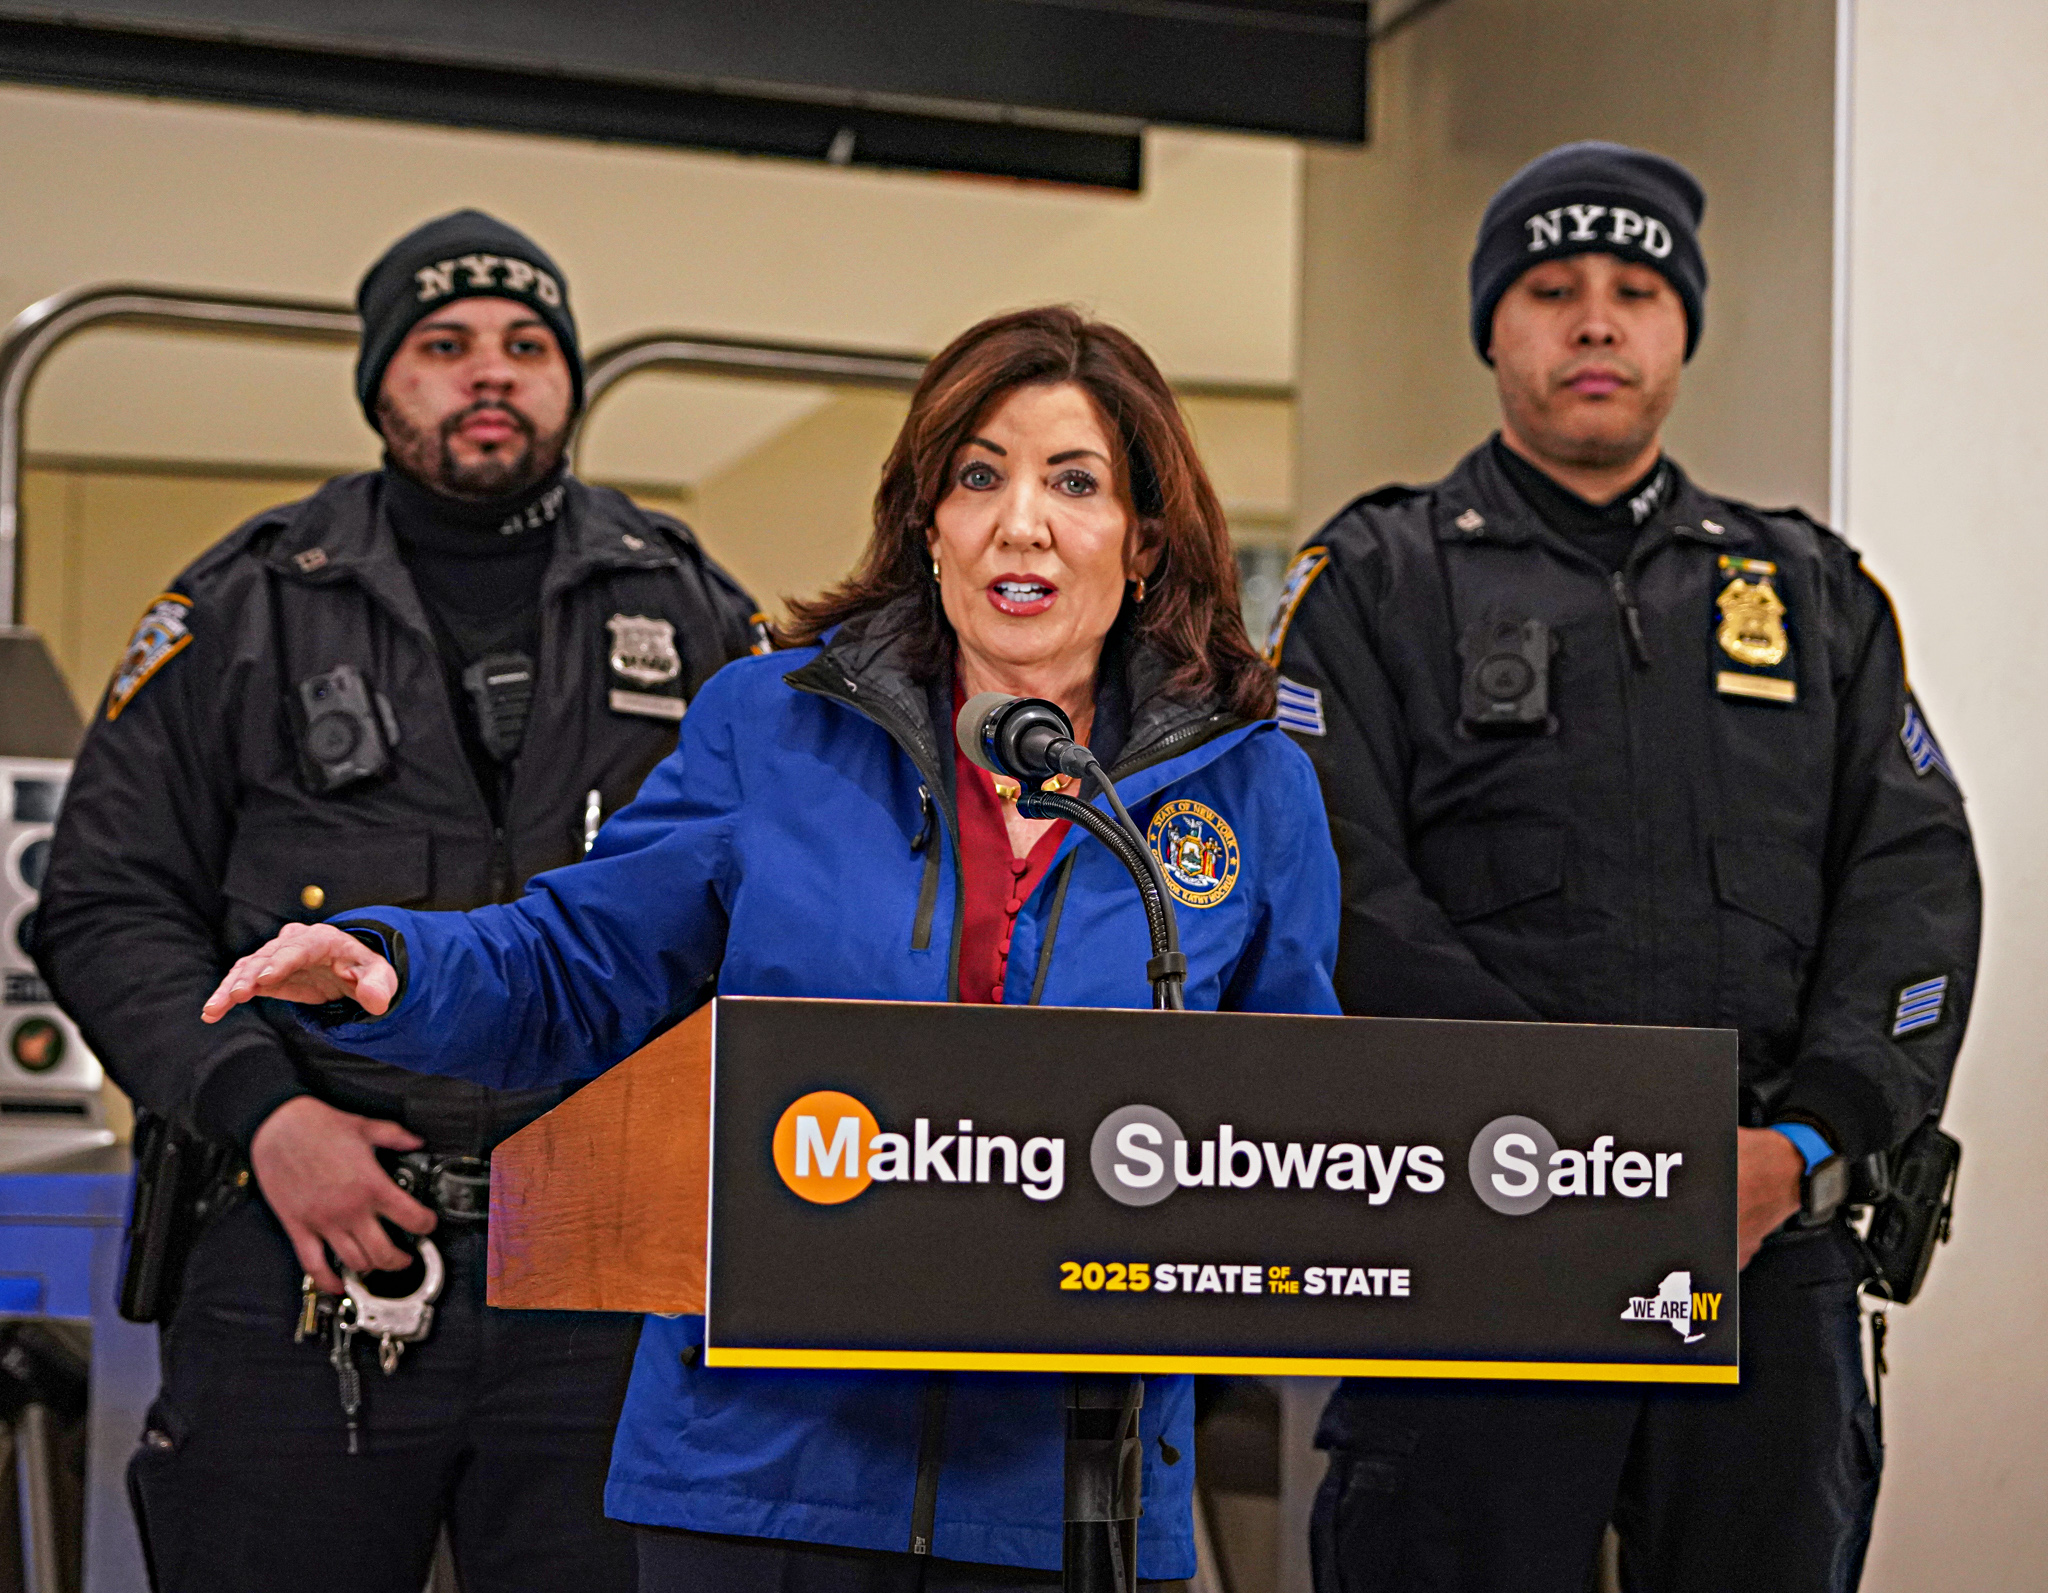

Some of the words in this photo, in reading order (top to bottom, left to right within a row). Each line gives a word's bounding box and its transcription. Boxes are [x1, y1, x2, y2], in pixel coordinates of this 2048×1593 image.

[1524, 203, 1673, 259] NYPD
[414, 253, 560, 308] NYPD
[1153, 804, 1176, 827] STATE
[1178, 802, 1191, 812] OF
[1193, 804, 1215, 821] NEW
[1216, 818, 1236, 849] YORK
[1181, 890, 1209, 904] KATHY
[794, 1115, 1065, 1201] Making
[1113, 1122, 1446, 1206] Subways
[1490, 1132, 1684, 1199] Safer
[1060, 1261, 1151, 1292] 2025
[1154, 1263, 1263, 1294] STATE
[1268, 1265, 1291, 1280] OF
[1268, 1280, 1299, 1294] THE
[1303, 1266, 1411, 1297] STATE
[1633, 1300, 1655, 1318] WE
[1660, 1301, 1688, 1319] ARE
[1692, 1292, 1722, 1321] NY
